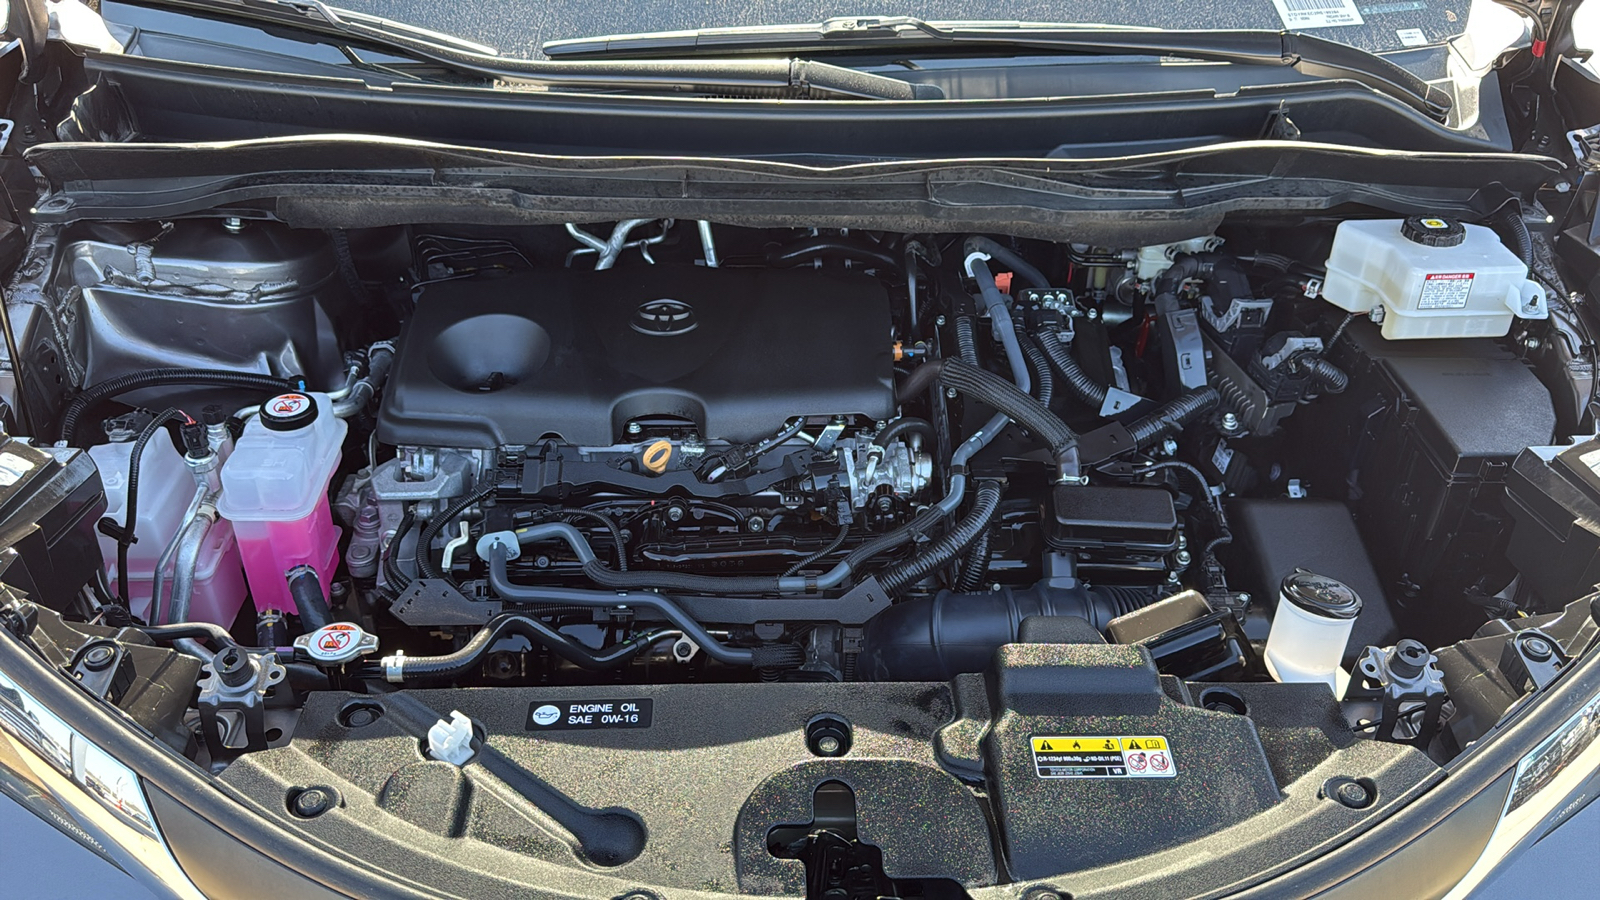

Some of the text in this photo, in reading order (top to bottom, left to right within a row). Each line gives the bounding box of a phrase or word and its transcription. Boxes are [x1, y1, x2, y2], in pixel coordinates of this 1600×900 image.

[569, 703, 640, 713] ENGINE OIL
[568, 714, 639, 724] SAE 0W-16
